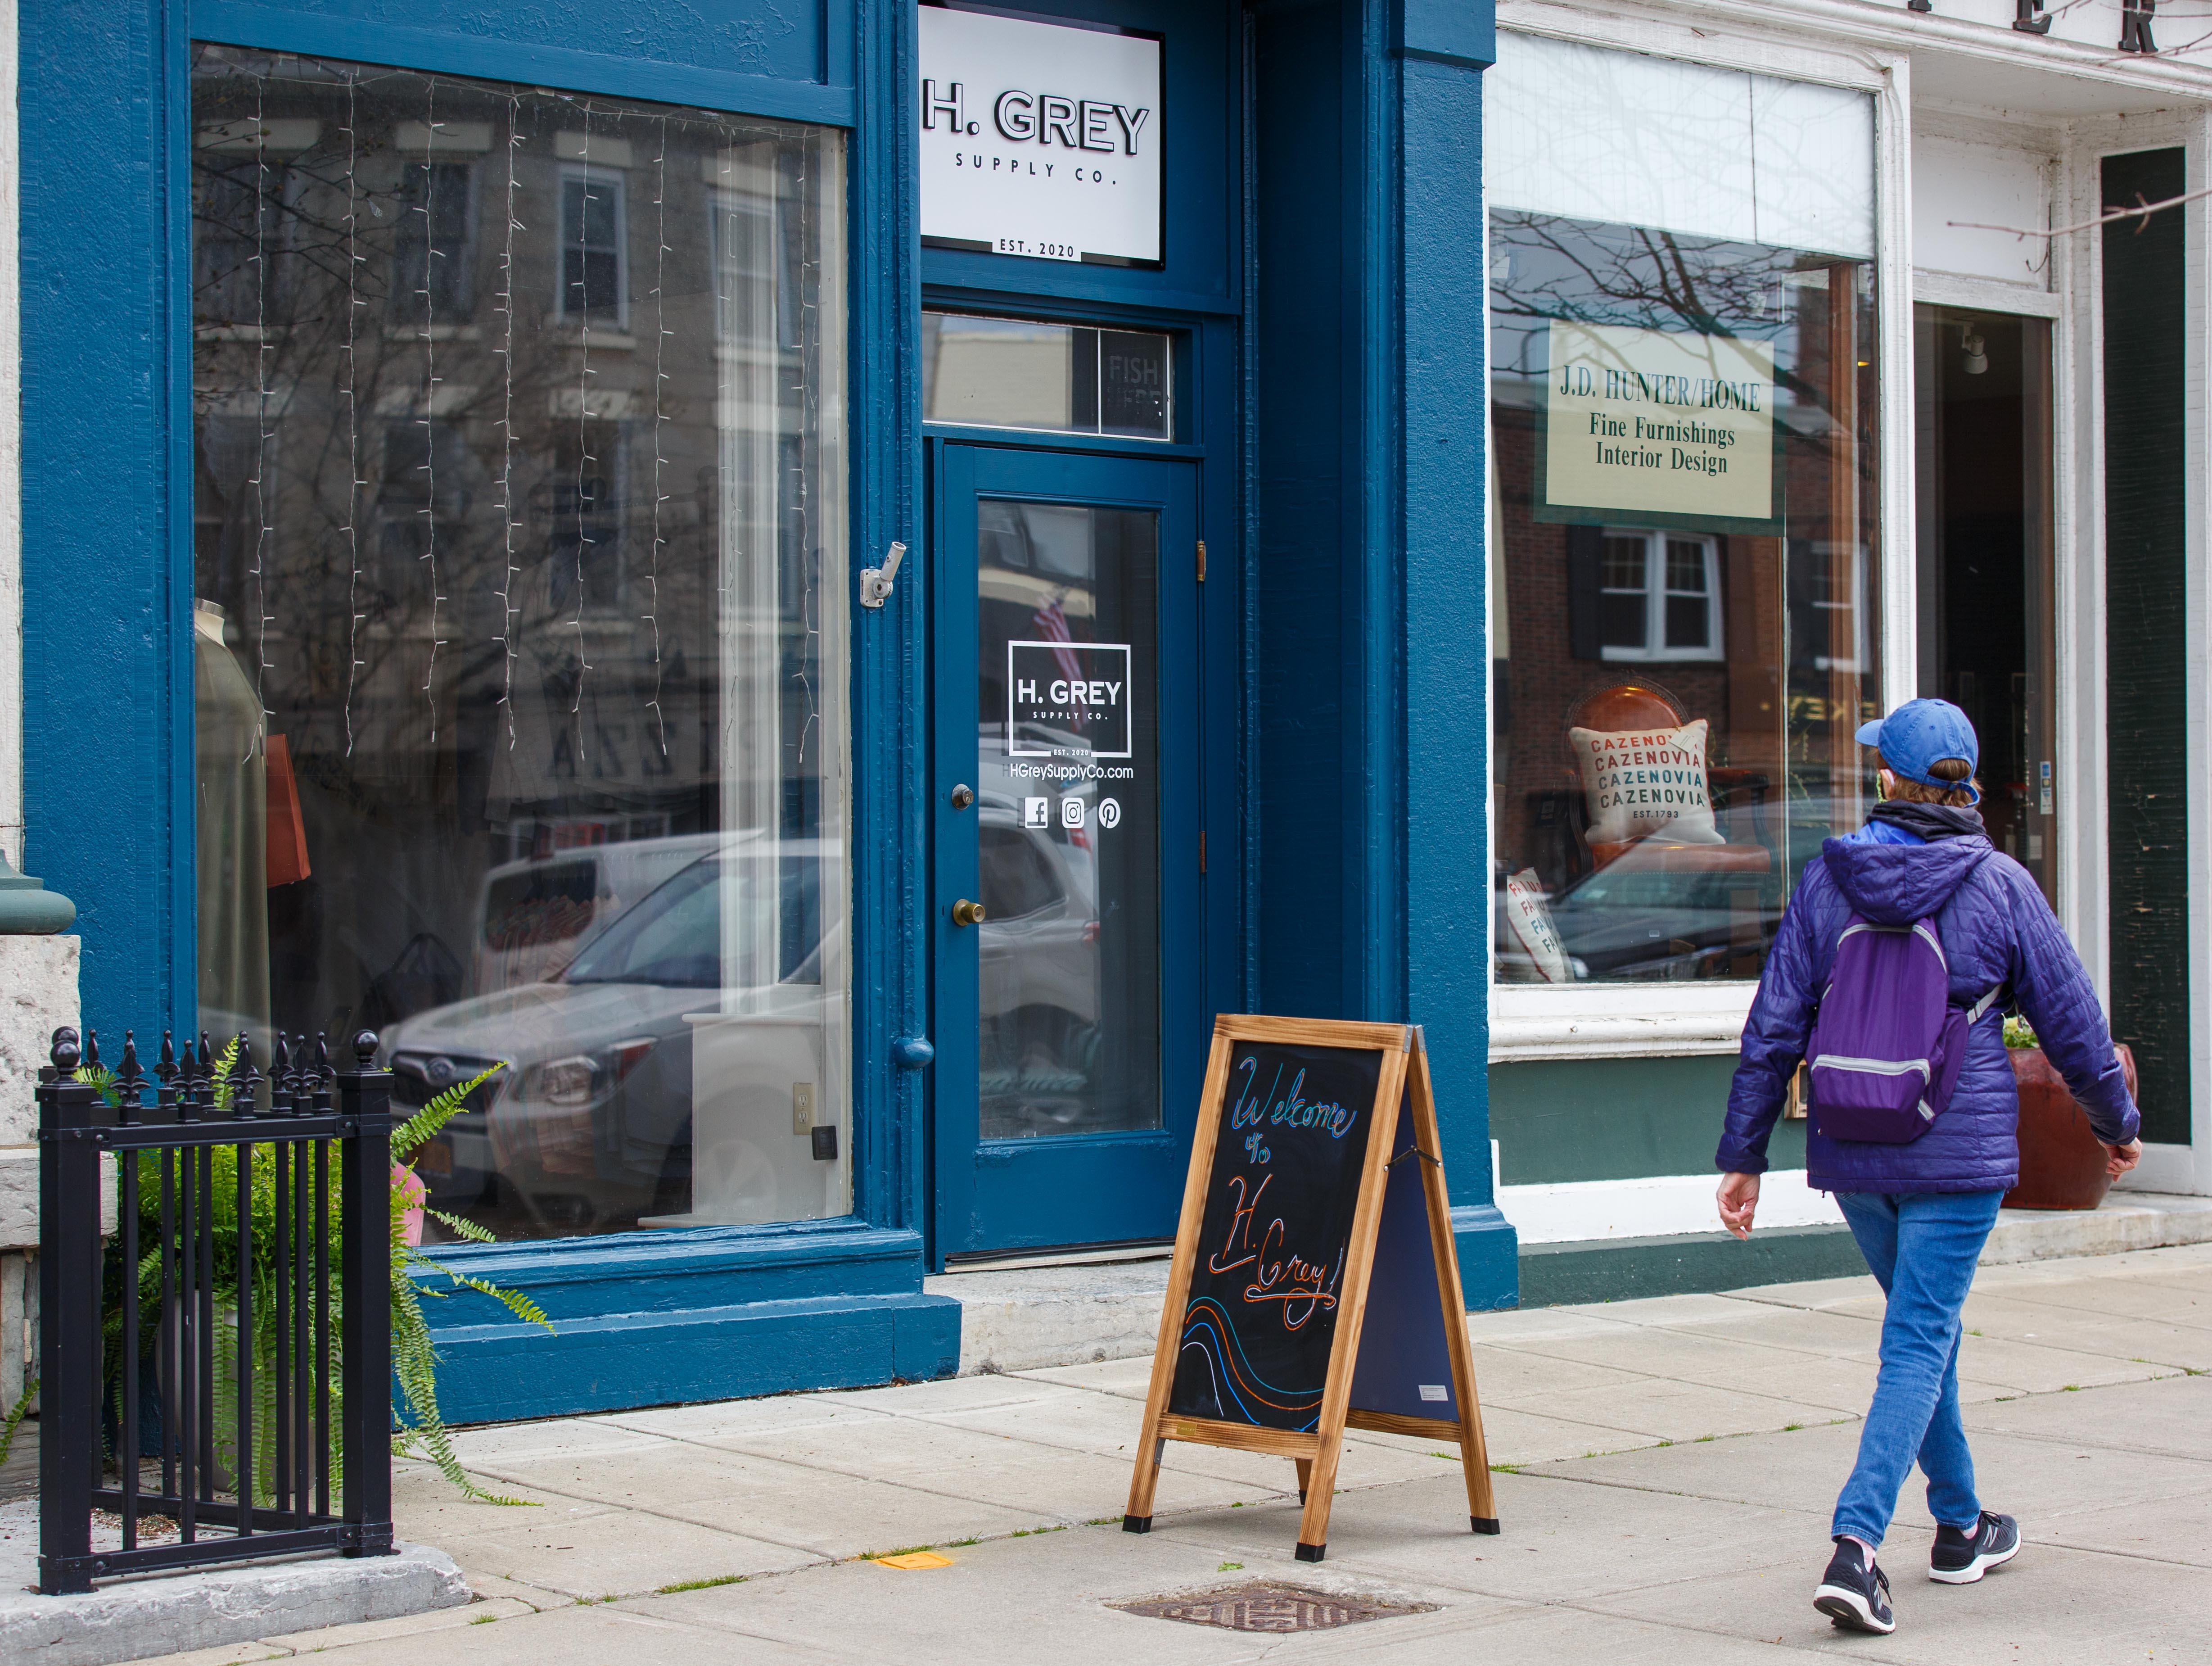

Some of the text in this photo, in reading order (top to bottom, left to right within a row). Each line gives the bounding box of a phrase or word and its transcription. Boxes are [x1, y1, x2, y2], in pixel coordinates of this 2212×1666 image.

[923, 79, 1150, 155] H. GREY
[956, 153, 1116, 185] SUPPLY CO.
[1000, 239, 1074, 258] EST. 2020
[1110, 356, 1158, 385] FISH
[1560, 365, 1761, 412] J.D. HUNTER/HOME
[1589, 412, 1735, 449] Fine Furnishings
[1596, 441, 1728, 476] Interior Design
[1018, 679, 1122, 705] H. GREY
[1033, 711, 1079, 720] SUPPLY
[1591, 735, 1697, 752] CAZENO
[1010, 763, 1134, 781] HGreySupplyCo.com
[1595, 751, 1700, 771] CAZENOVIA
[1598, 770, 1702, 789] CAZENOVIA
[1600, 789, 1705, 809] CAZENOVIA
[1633, 810, 1679, 819] EST.1793
[1232, 1056, 1357, 1138] Welcome
[1245, 1132, 1270, 1164] to
